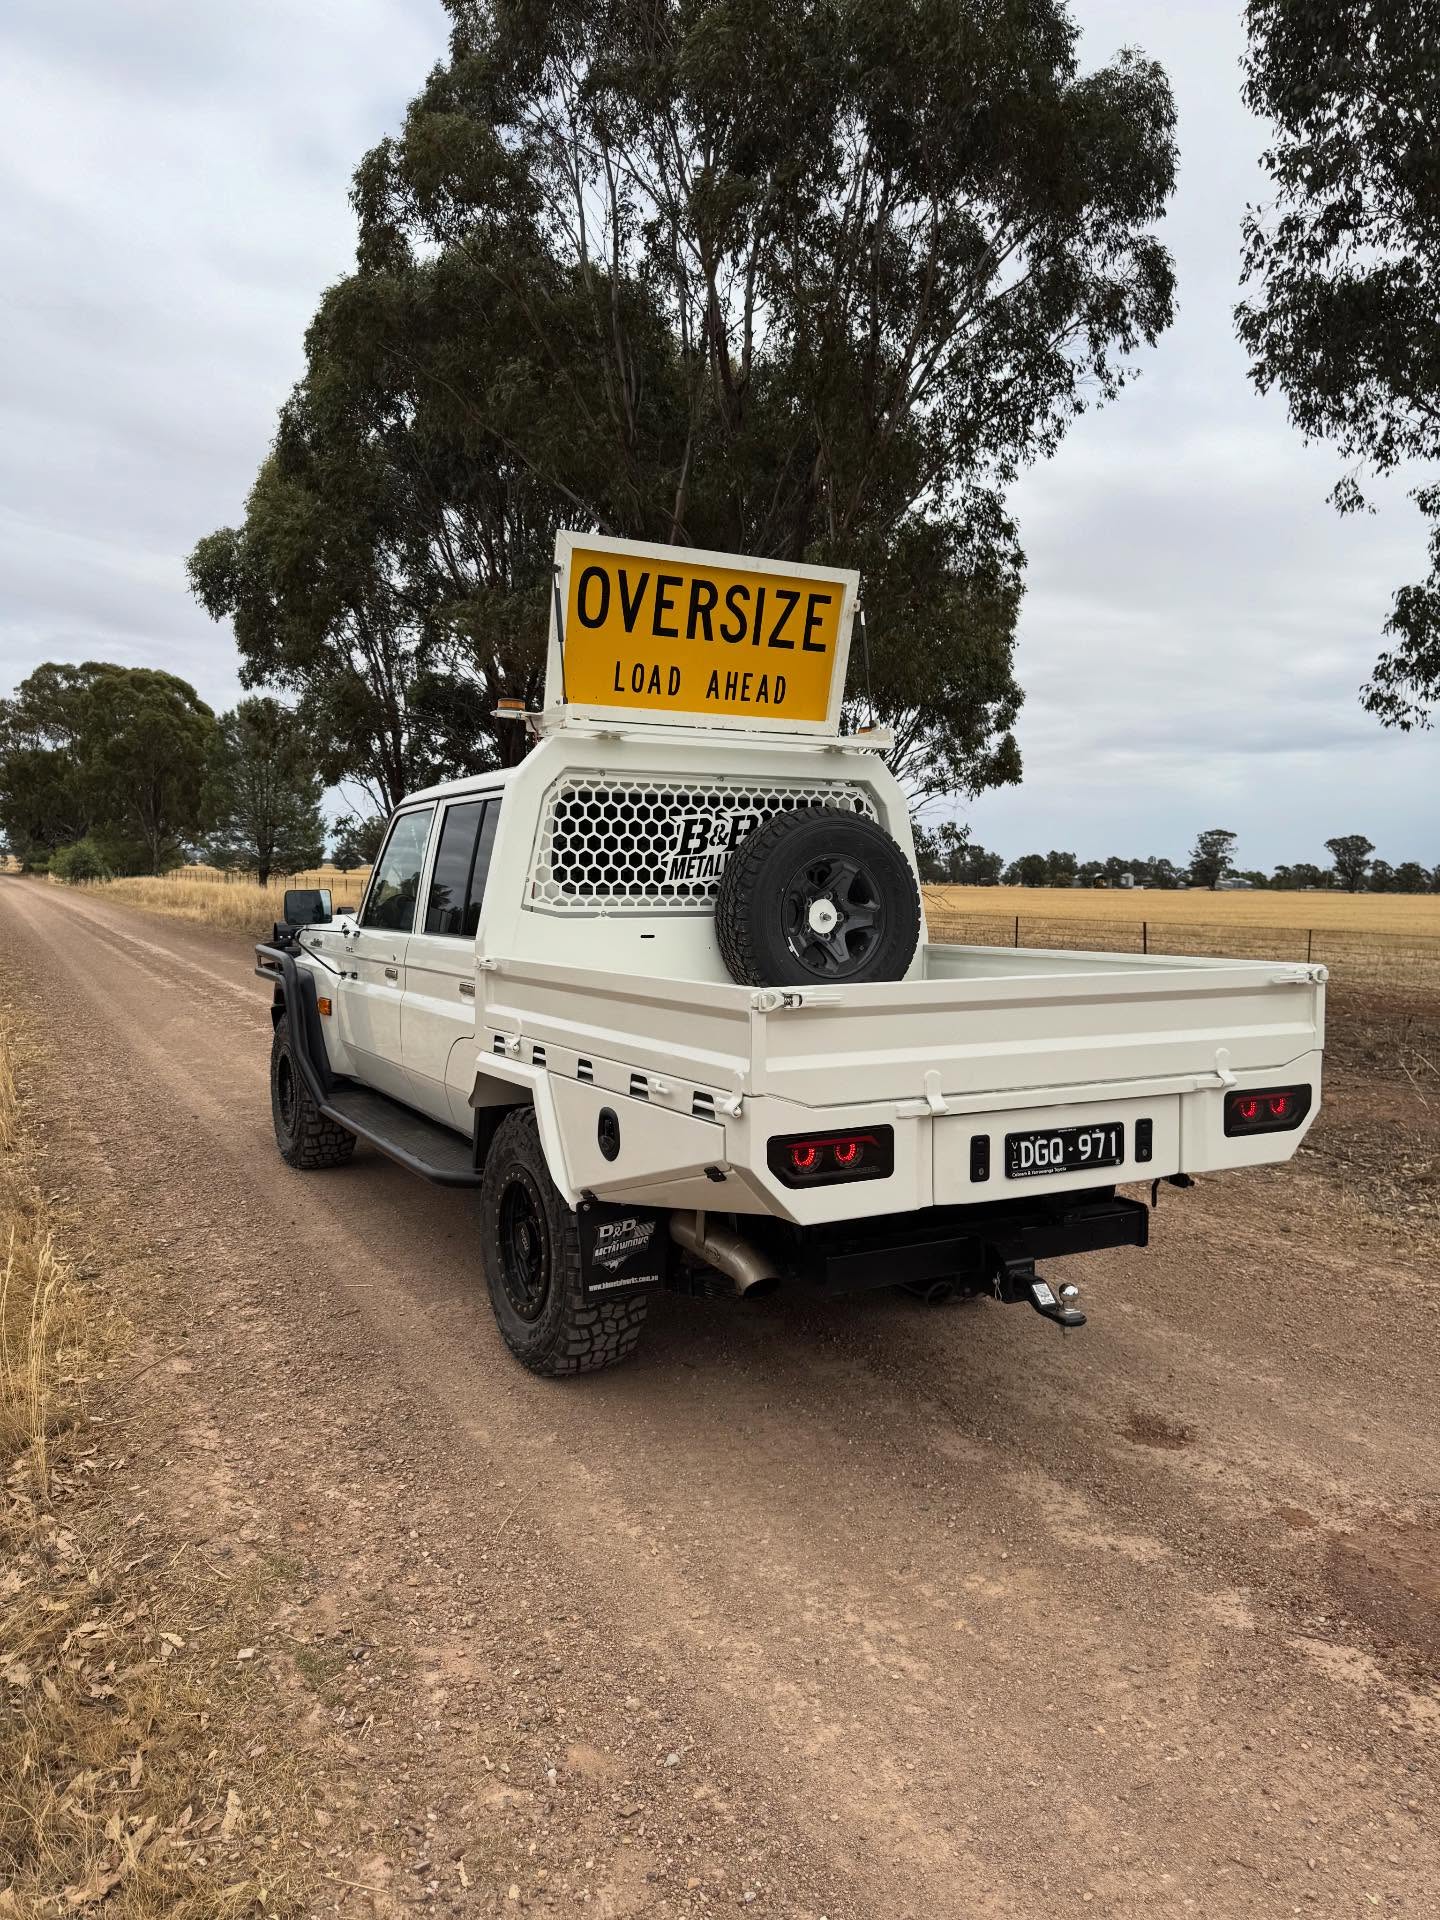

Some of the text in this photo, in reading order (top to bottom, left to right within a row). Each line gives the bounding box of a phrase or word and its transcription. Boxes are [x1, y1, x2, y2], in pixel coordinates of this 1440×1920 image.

[577, 566, 832, 652] OVERSIZE
[614, 661, 787, 705] LOAD AHEAD
